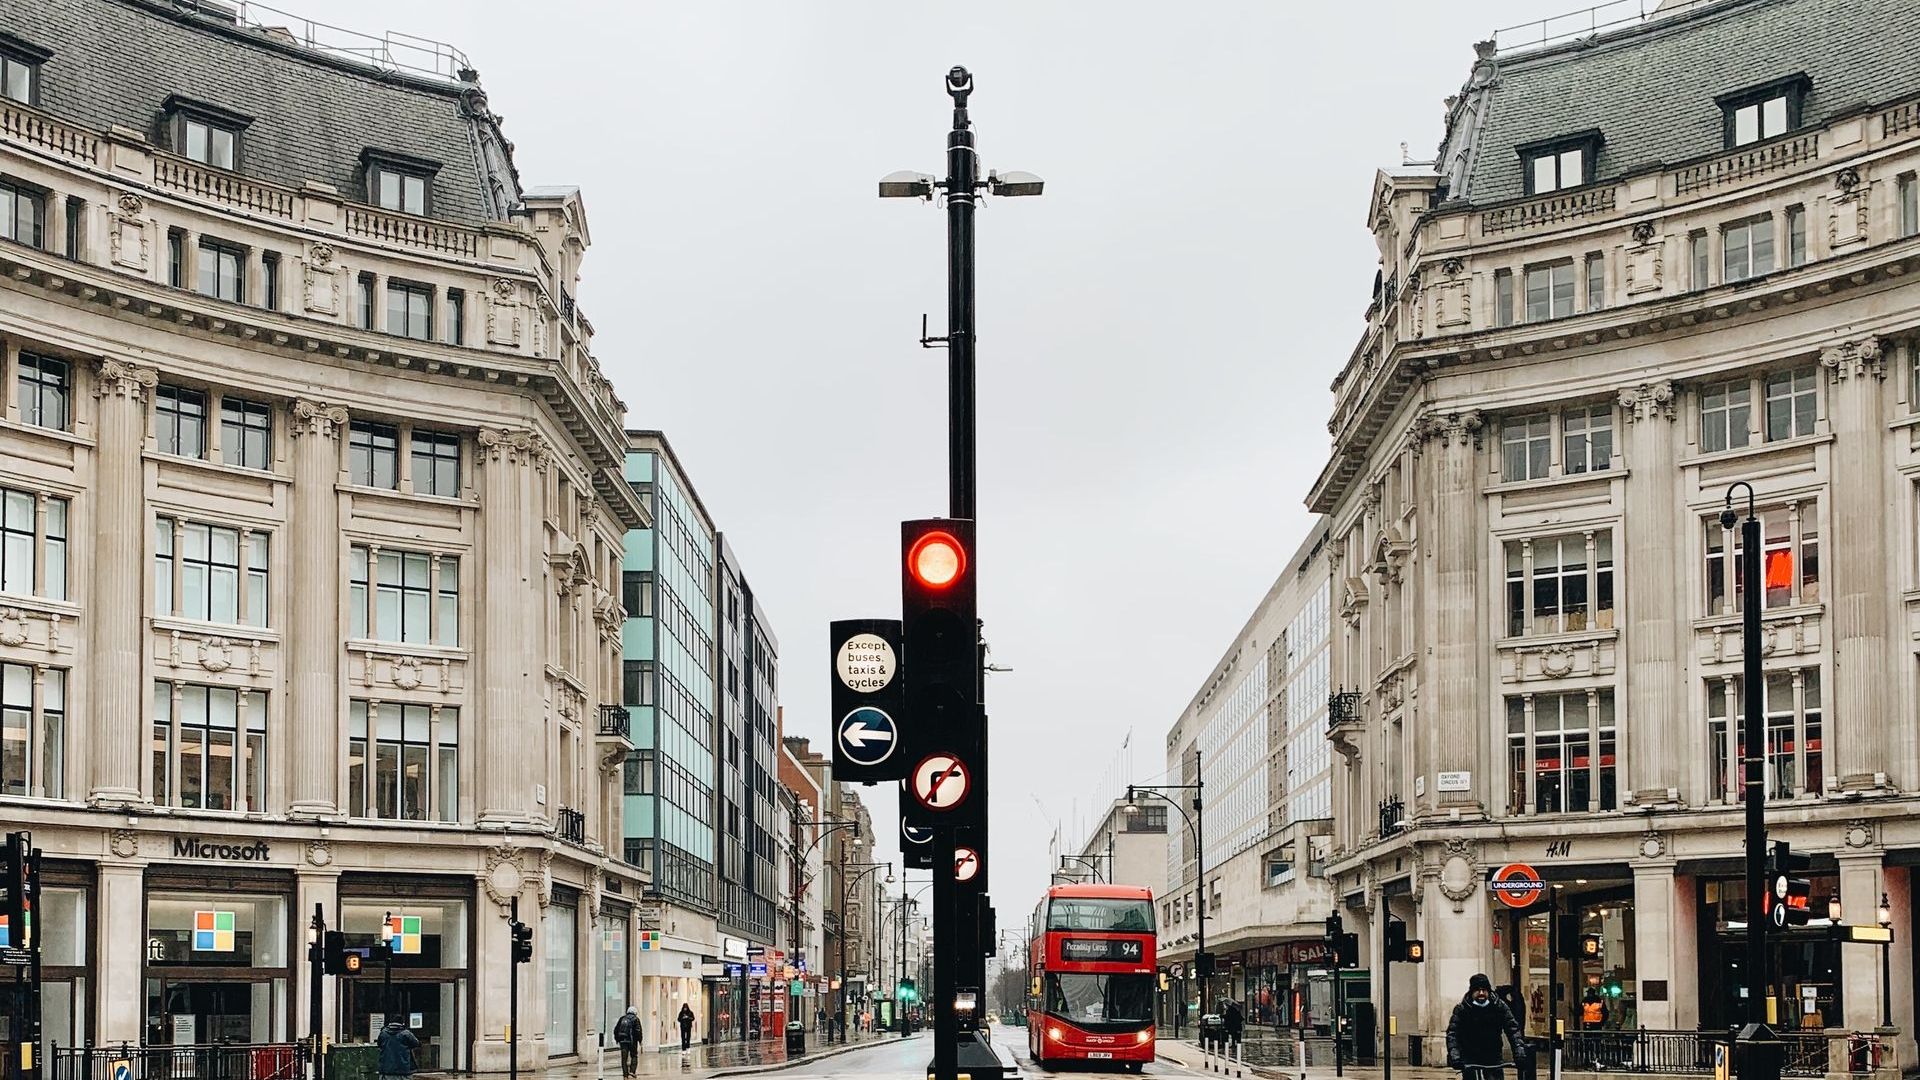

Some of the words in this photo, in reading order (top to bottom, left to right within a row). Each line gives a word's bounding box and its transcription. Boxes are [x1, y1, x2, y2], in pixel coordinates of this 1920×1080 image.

[847, 641, 886, 651] Except
[848, 665, 876, 675] taxis
[878, 665, 886, 675] &
[848, 678, 885, 688] cycles
[173, 838, 270, 861] Microsoft
[1546, 840, 1571, 857] H&M
[1066, 942, 1091, 953] Piccadilly
[1092, 943, 1108, 952] Circus
[1122, 942, 1139, 955] 94
